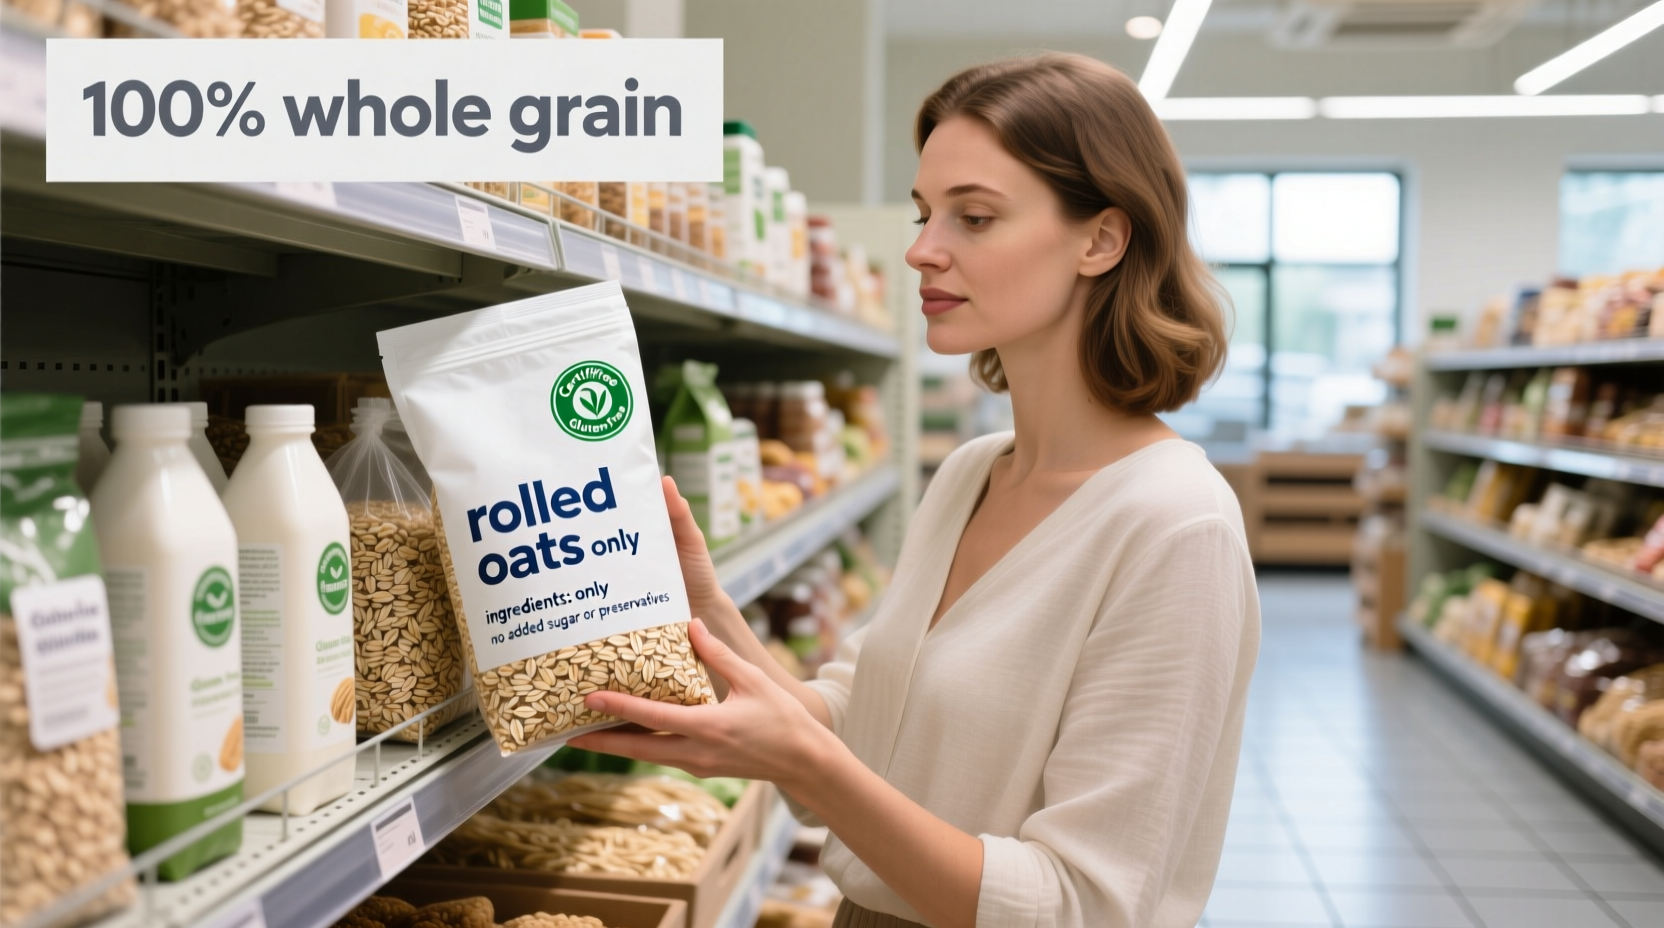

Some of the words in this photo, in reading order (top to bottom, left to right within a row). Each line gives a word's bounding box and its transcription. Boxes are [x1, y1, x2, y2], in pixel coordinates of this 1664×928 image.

[466, 466, 618, 544] rolled
[477, 531, 585, 586] oats
[591, 528, 640, 556] only
[485, 592, 573, 625] ingredients:
[574, 581, 609, 600] only
[491, 633, 505, 645] no
[508, 618, 545, 640] added
[547, 613, 580, 630] sugar
[583, 609, 596, 620] or
